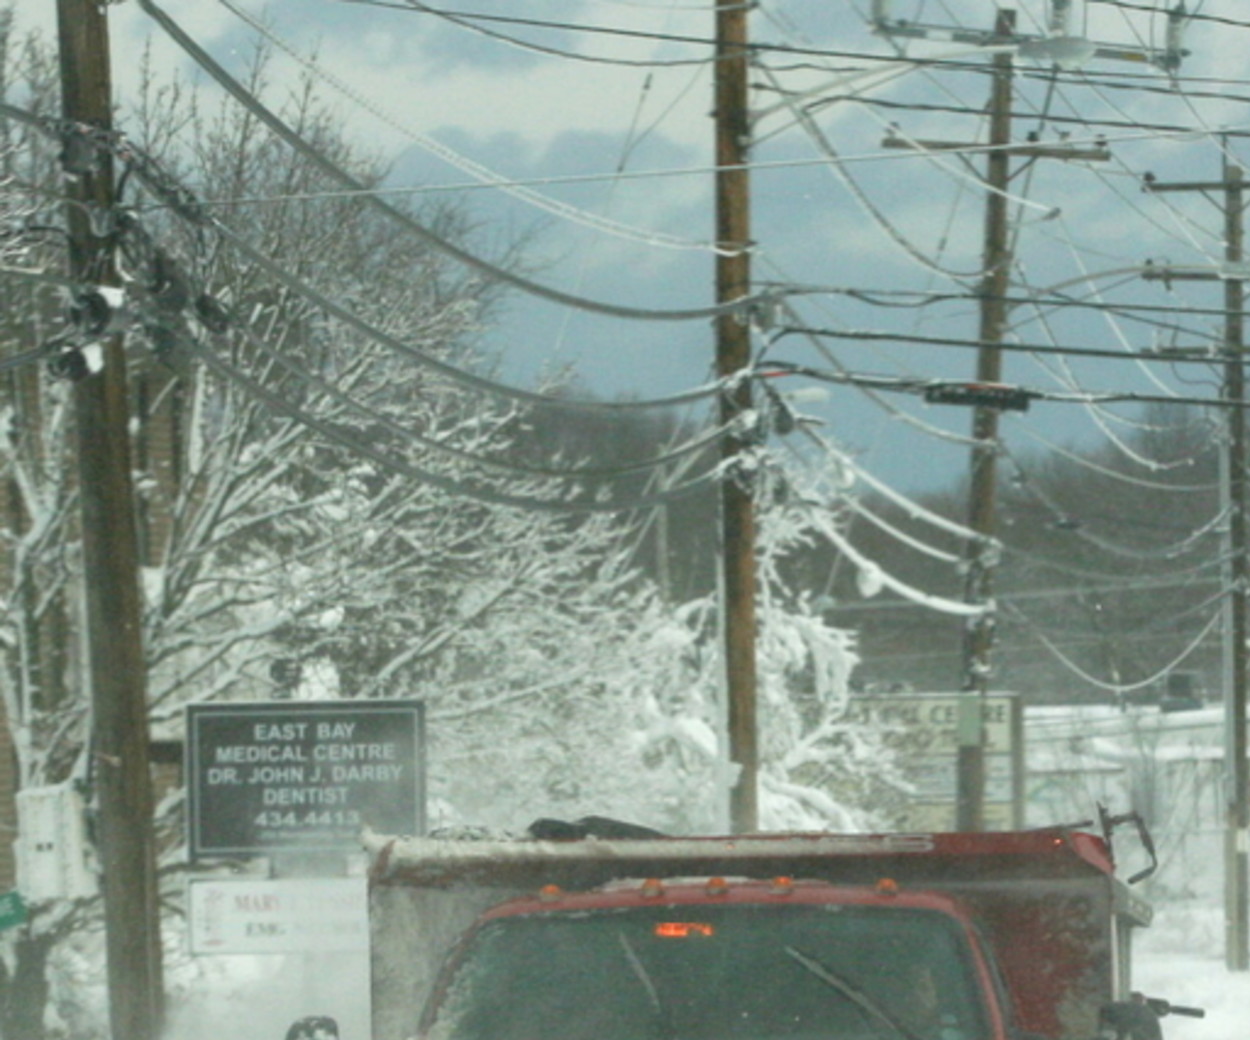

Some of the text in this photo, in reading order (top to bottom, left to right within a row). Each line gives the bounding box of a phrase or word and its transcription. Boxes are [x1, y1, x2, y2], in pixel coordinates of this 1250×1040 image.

[253, 721, 357, 741] EAST BAY
[215, 742, 396, 763] MEDICAL CENTRE
[206, 763, 403, 785] DR. JOHN J. DARBY
[262, 786, 349, 805] DENTIST
